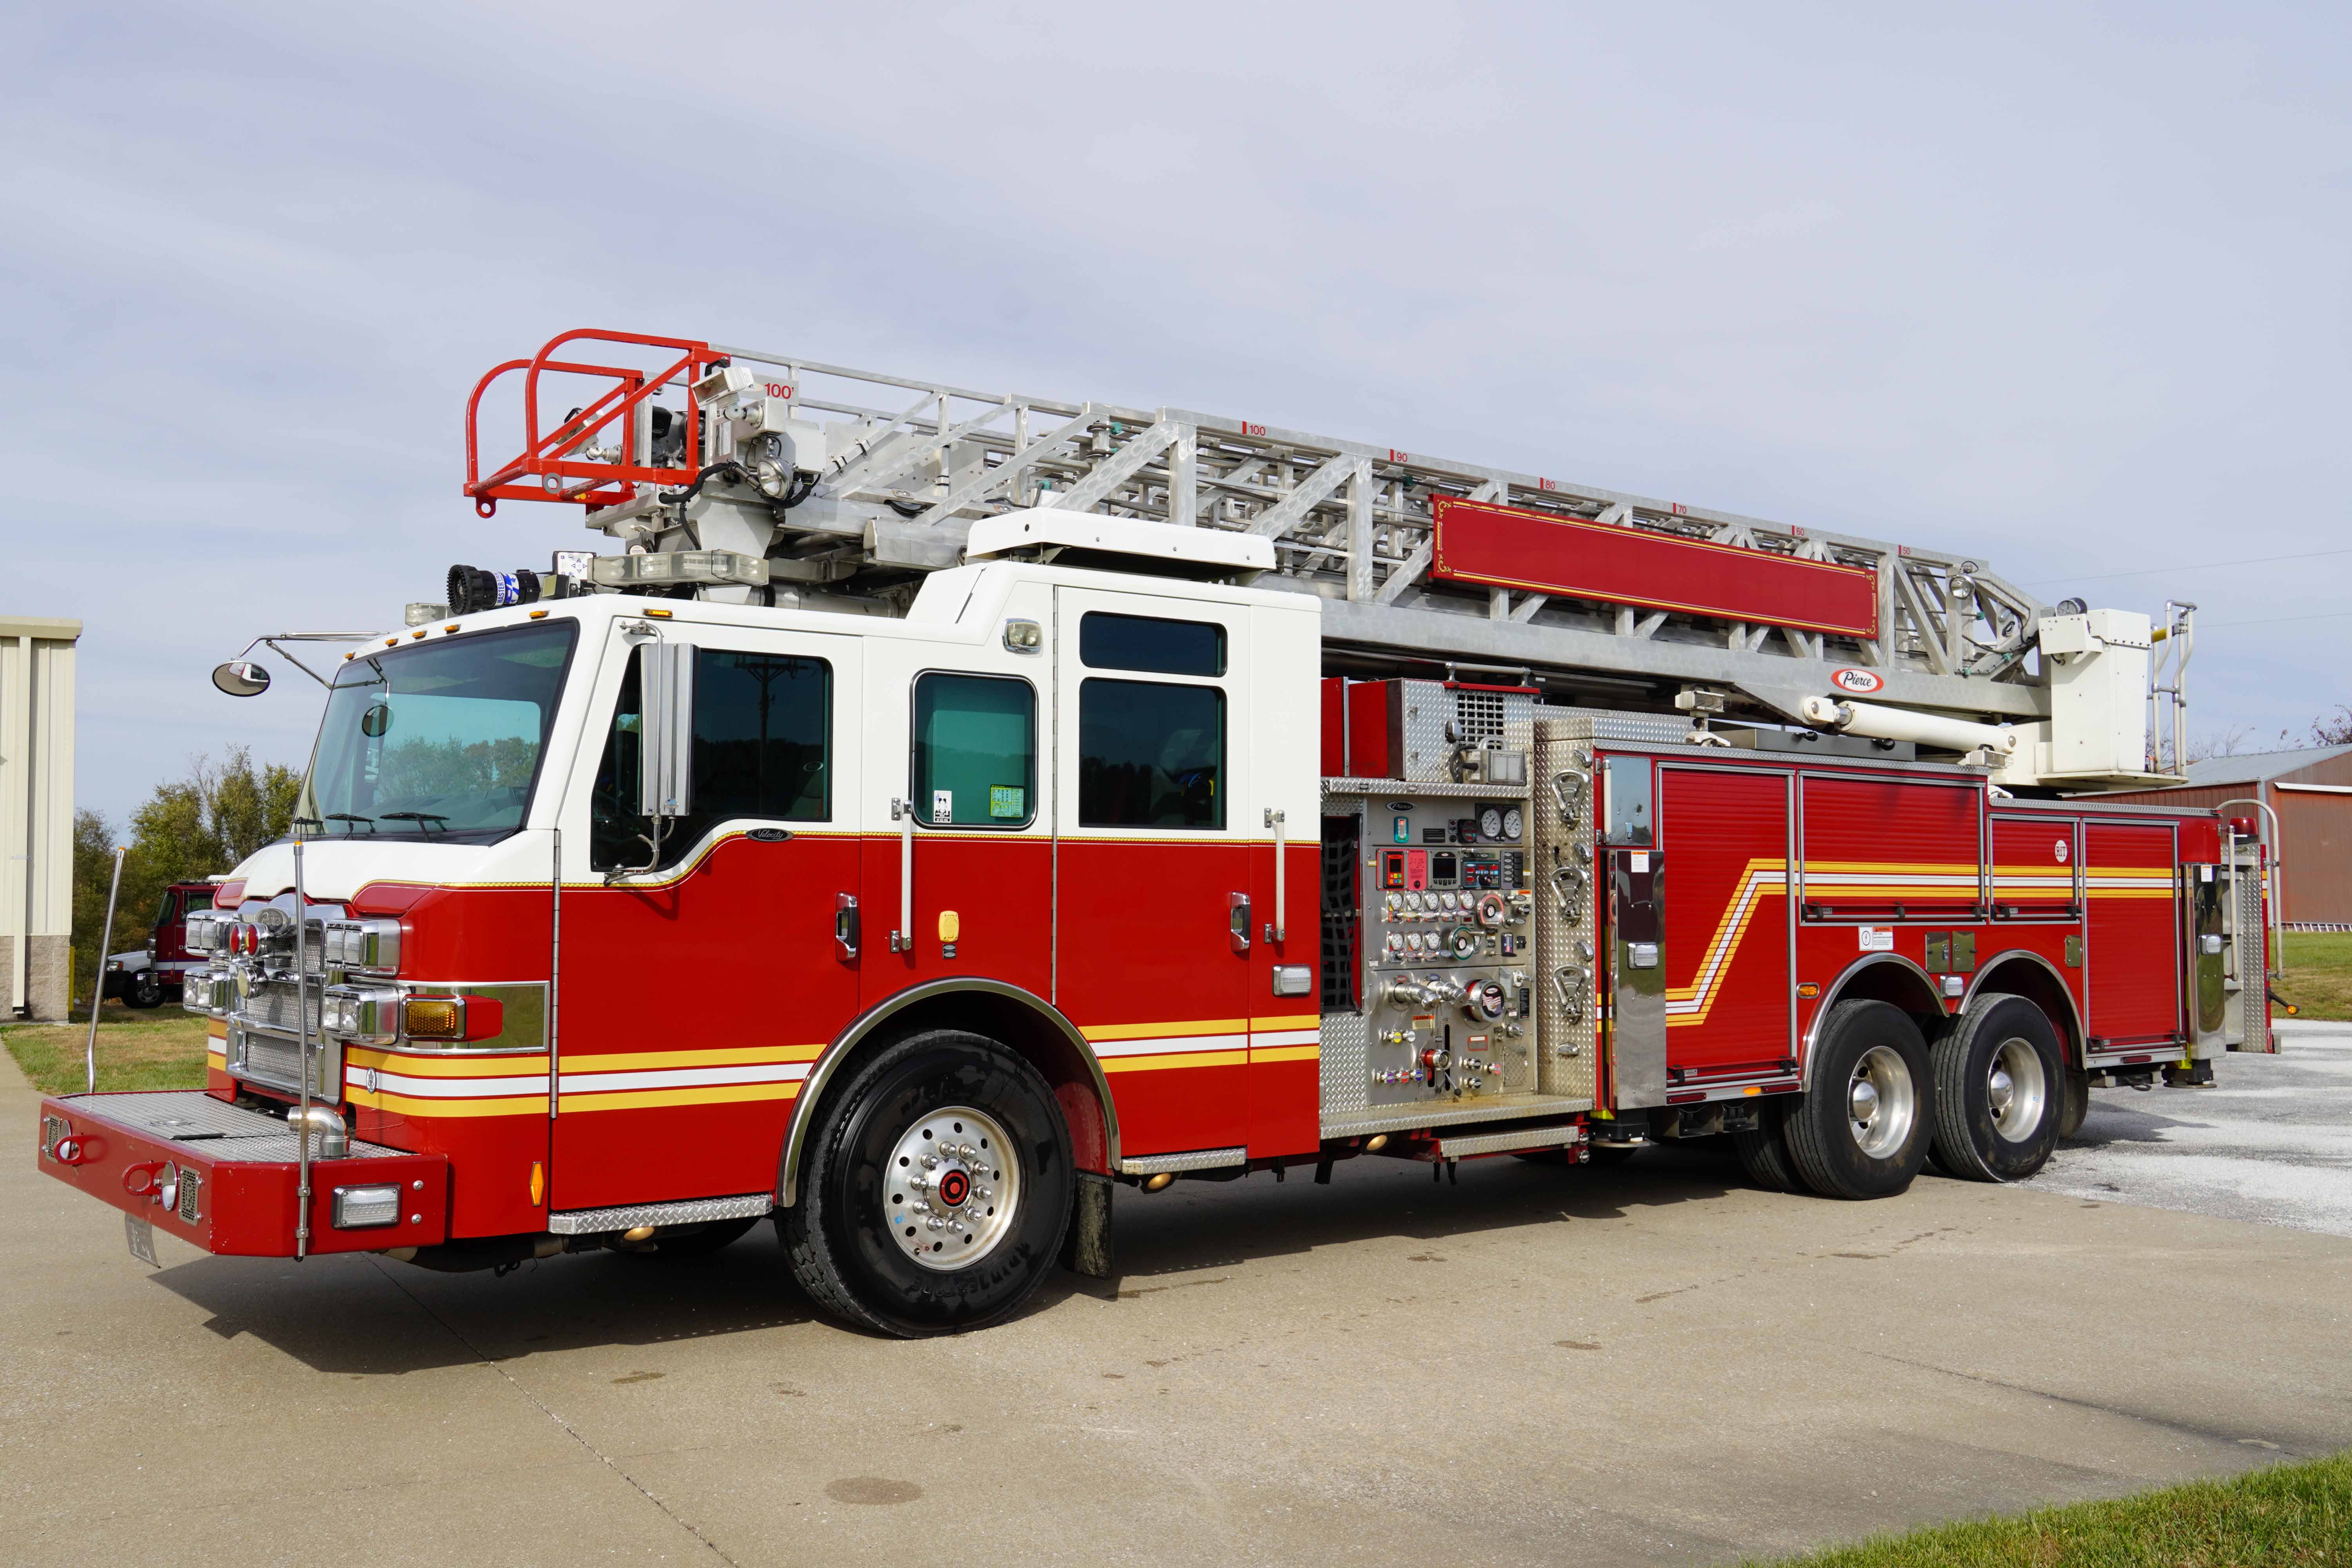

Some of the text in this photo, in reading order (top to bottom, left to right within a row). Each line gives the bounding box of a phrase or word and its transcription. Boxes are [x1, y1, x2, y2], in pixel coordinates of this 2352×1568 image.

[1249, 425, 1266, 436] 100
[1397, 452, 1407, 462] 90
[1546, 480, 1555, 490] 80
[1678, 505, 1687, 514] 70
[1796, 527, 1804, 536] 60
[1903, 547, 1910, 555] 50
[497, 582, 505, 603] MASTER
[1843, 671, 1872, 686] Pierce
[758, 829, 784, 840] Velocity
[2056, 846, 2066, 857] RIT
